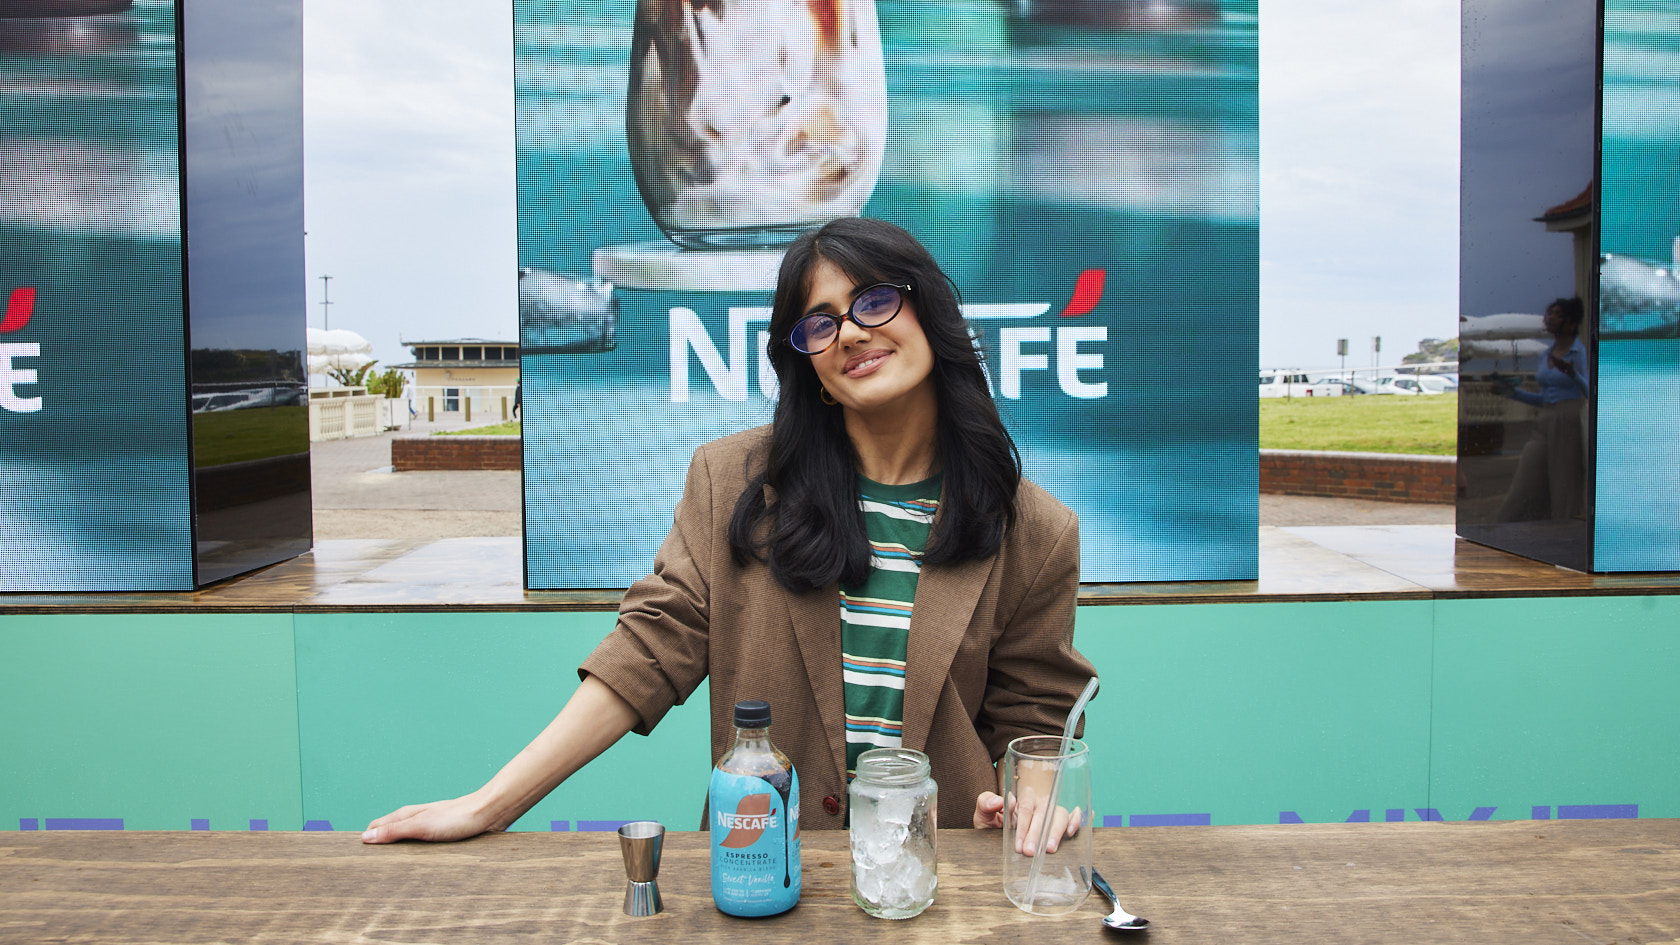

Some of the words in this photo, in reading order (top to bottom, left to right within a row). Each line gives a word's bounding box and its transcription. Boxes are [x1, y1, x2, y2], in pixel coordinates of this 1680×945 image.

[717, 808, 777, 830] NESCAFÉ
[726, 851, 769, 860] ESPRESSO
[719, 856, 777, 866] CONCENTRATE
